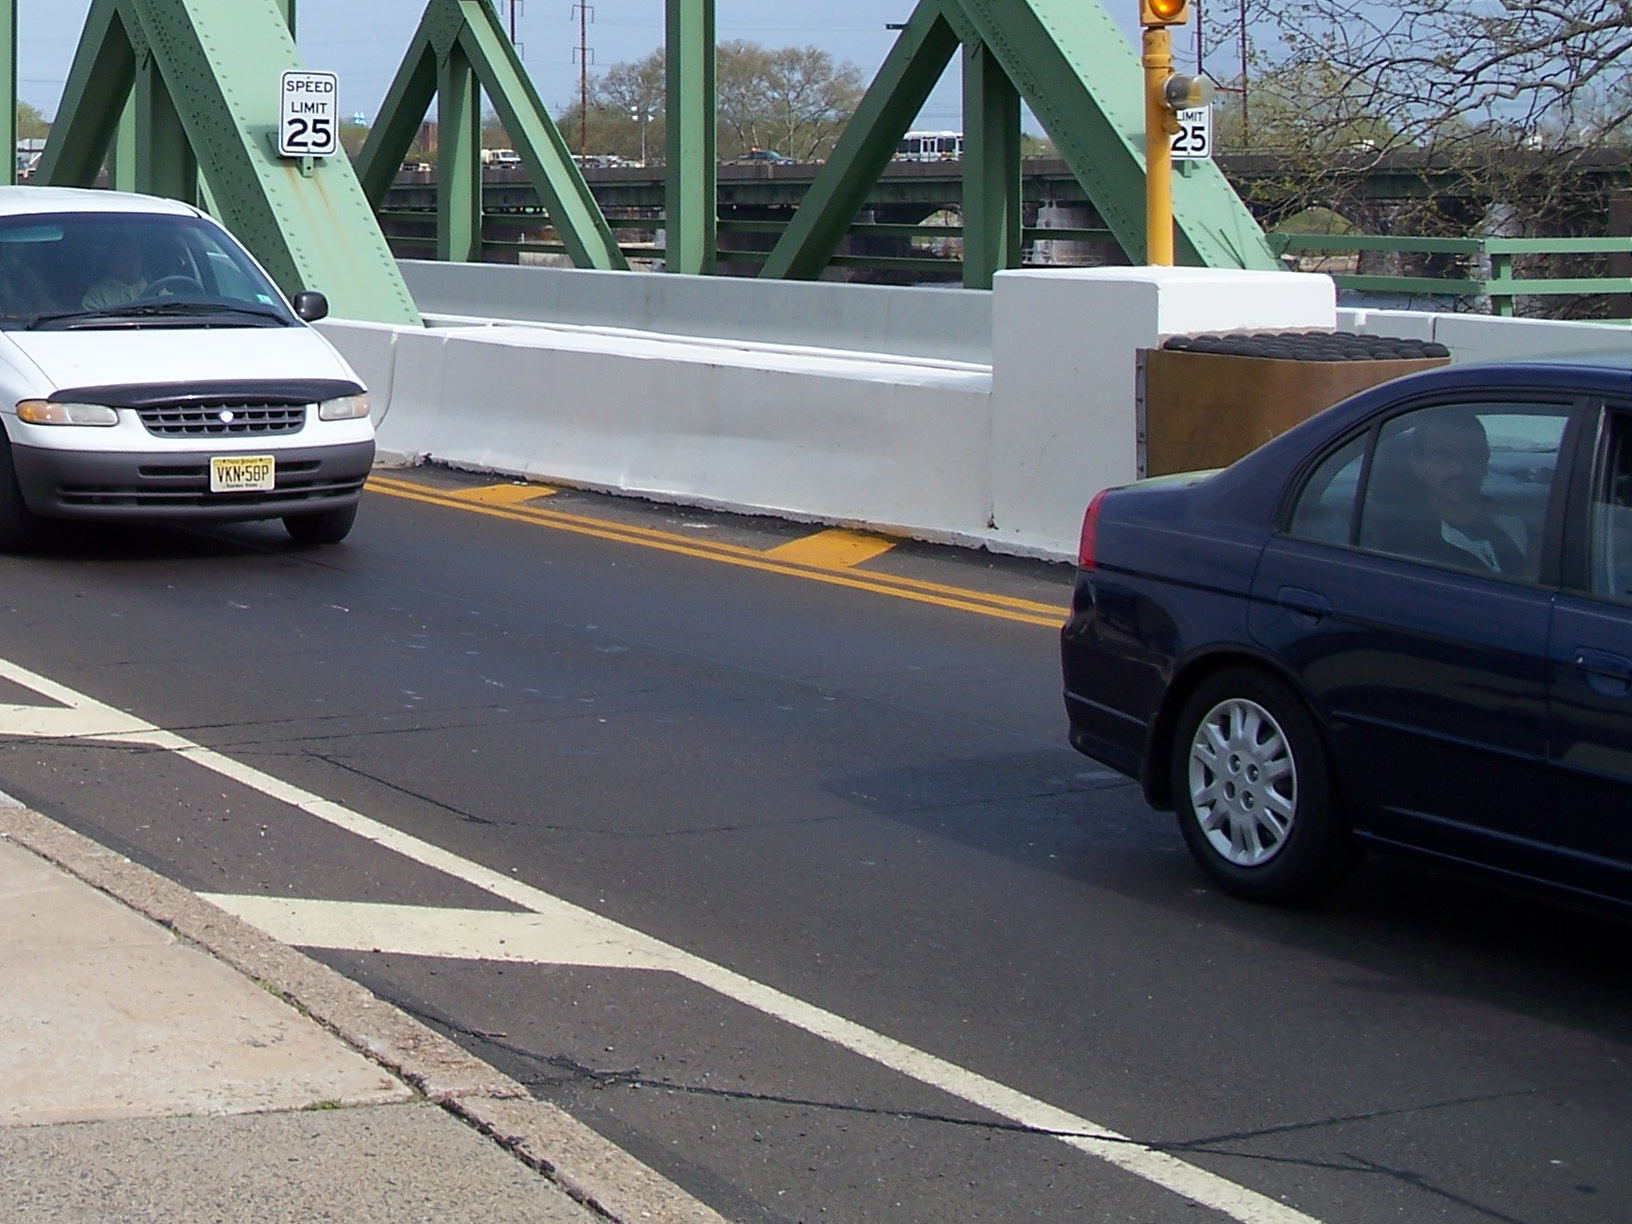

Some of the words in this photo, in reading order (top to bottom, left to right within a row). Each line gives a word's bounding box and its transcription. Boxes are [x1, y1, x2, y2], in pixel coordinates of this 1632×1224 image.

[286, 80, 333, 93] SPEED
[291, 101, 328, 114] LIMIT
[286, 118, 331, 148] 25
[1171, 126, 1206, 152] 25
